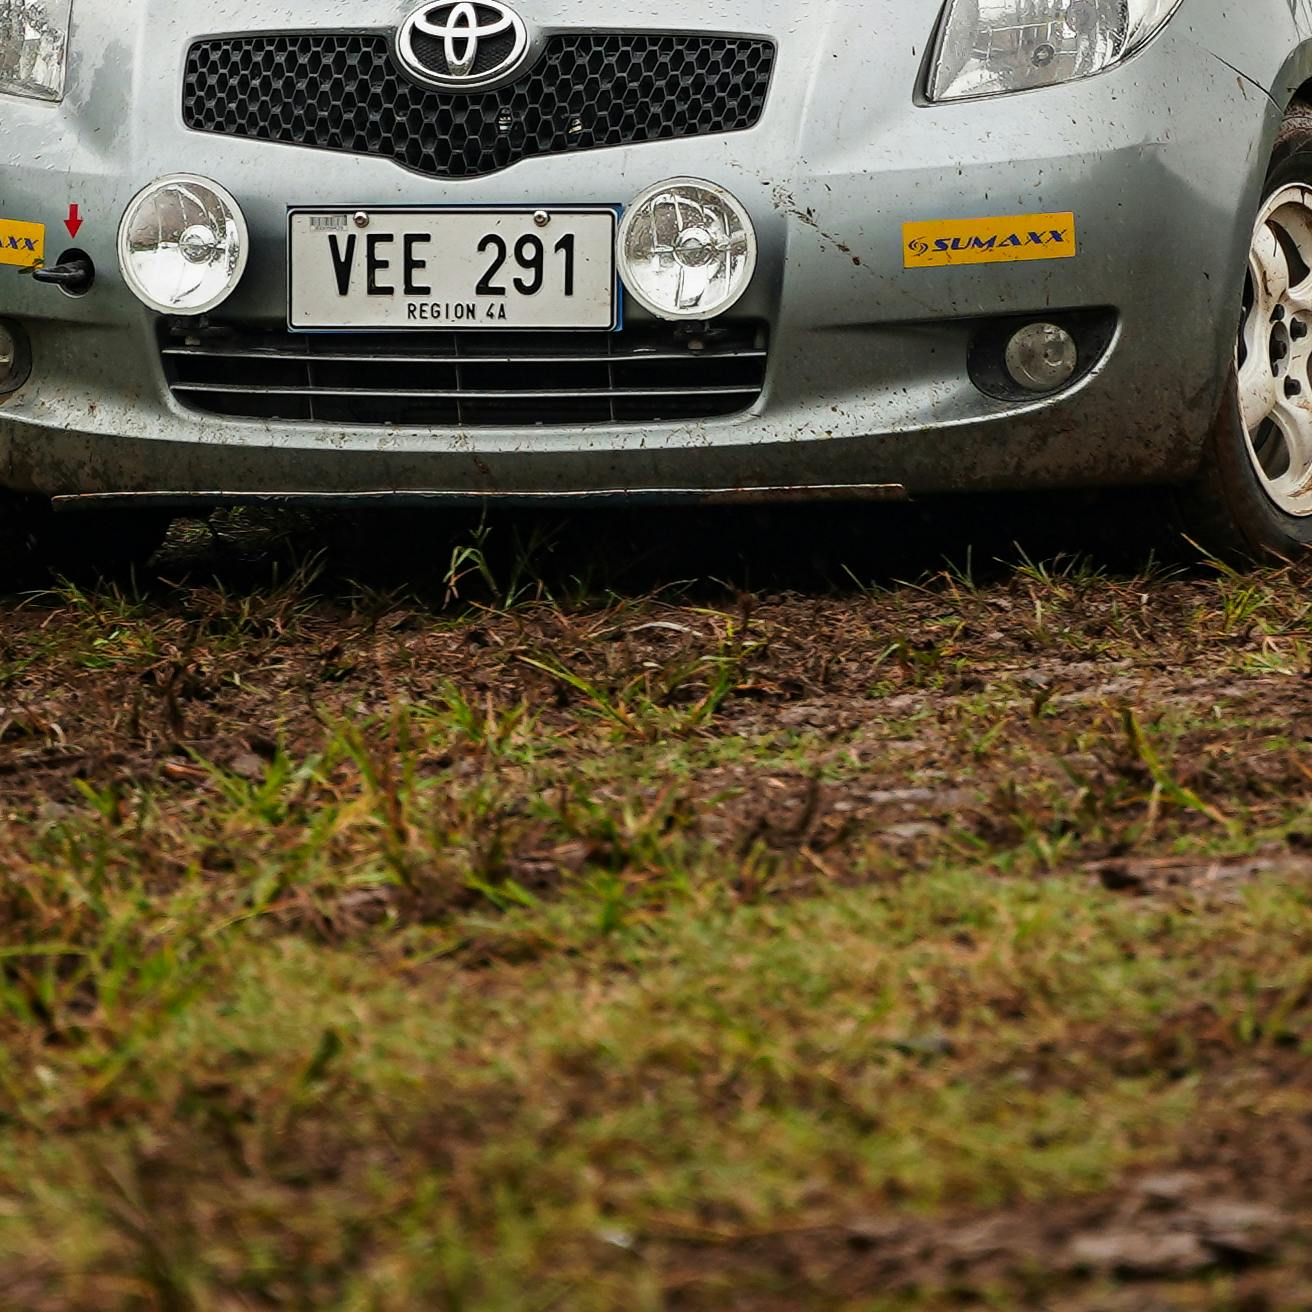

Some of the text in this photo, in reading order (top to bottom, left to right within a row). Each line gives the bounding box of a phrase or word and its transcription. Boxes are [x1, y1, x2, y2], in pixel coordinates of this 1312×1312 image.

[932, 229, 1067, 252] SUMAXX
[328, 233, 575, 296] VEE 291
[407, 303, 507, 320] REGION 4A
